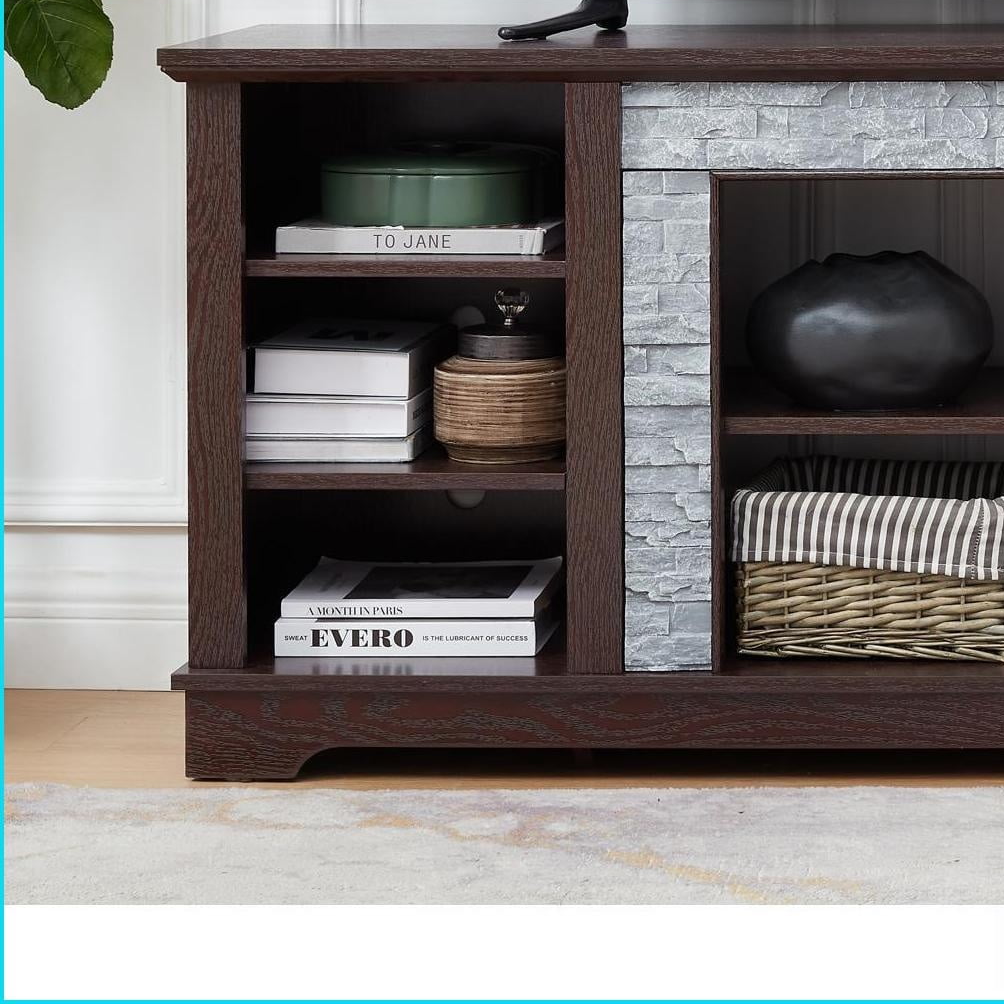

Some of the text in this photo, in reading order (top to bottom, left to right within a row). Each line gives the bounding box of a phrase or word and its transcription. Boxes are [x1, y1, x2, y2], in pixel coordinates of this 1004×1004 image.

[373, 234, 451, 249] TO JANE
[306, 606, 403, 615] A MONTH IN PARIS
[310, 629, 414, 647] EVERO
